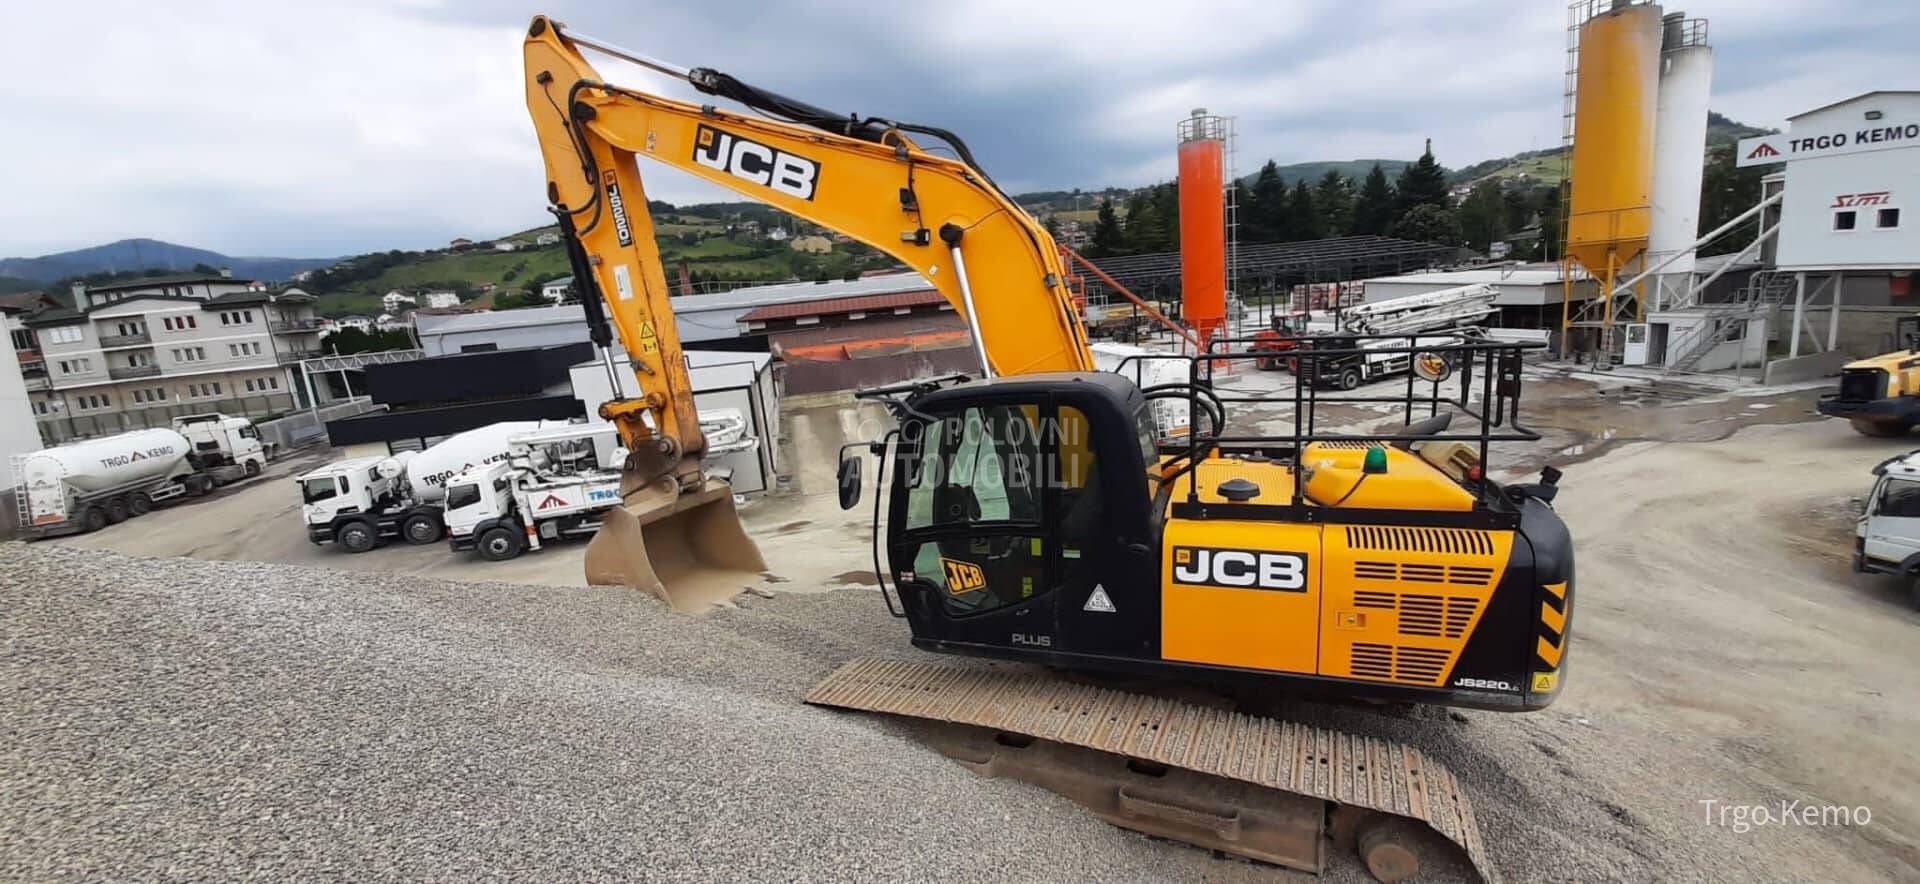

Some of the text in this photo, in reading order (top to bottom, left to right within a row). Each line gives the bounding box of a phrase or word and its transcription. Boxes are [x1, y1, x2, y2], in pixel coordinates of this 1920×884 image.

[1789, 124, 1920, 153] TRGO KEMO
[696, 133, 815, 200] JCB
[100, 446, 174, 469] TRGO KEMO
[423, 451, 511, 486] TRGO KEM
[946, 562, 983, 592] JCB
[1175, 550, 1304, 589] JCB
[1012, 633, 1051, 646] PLUS
